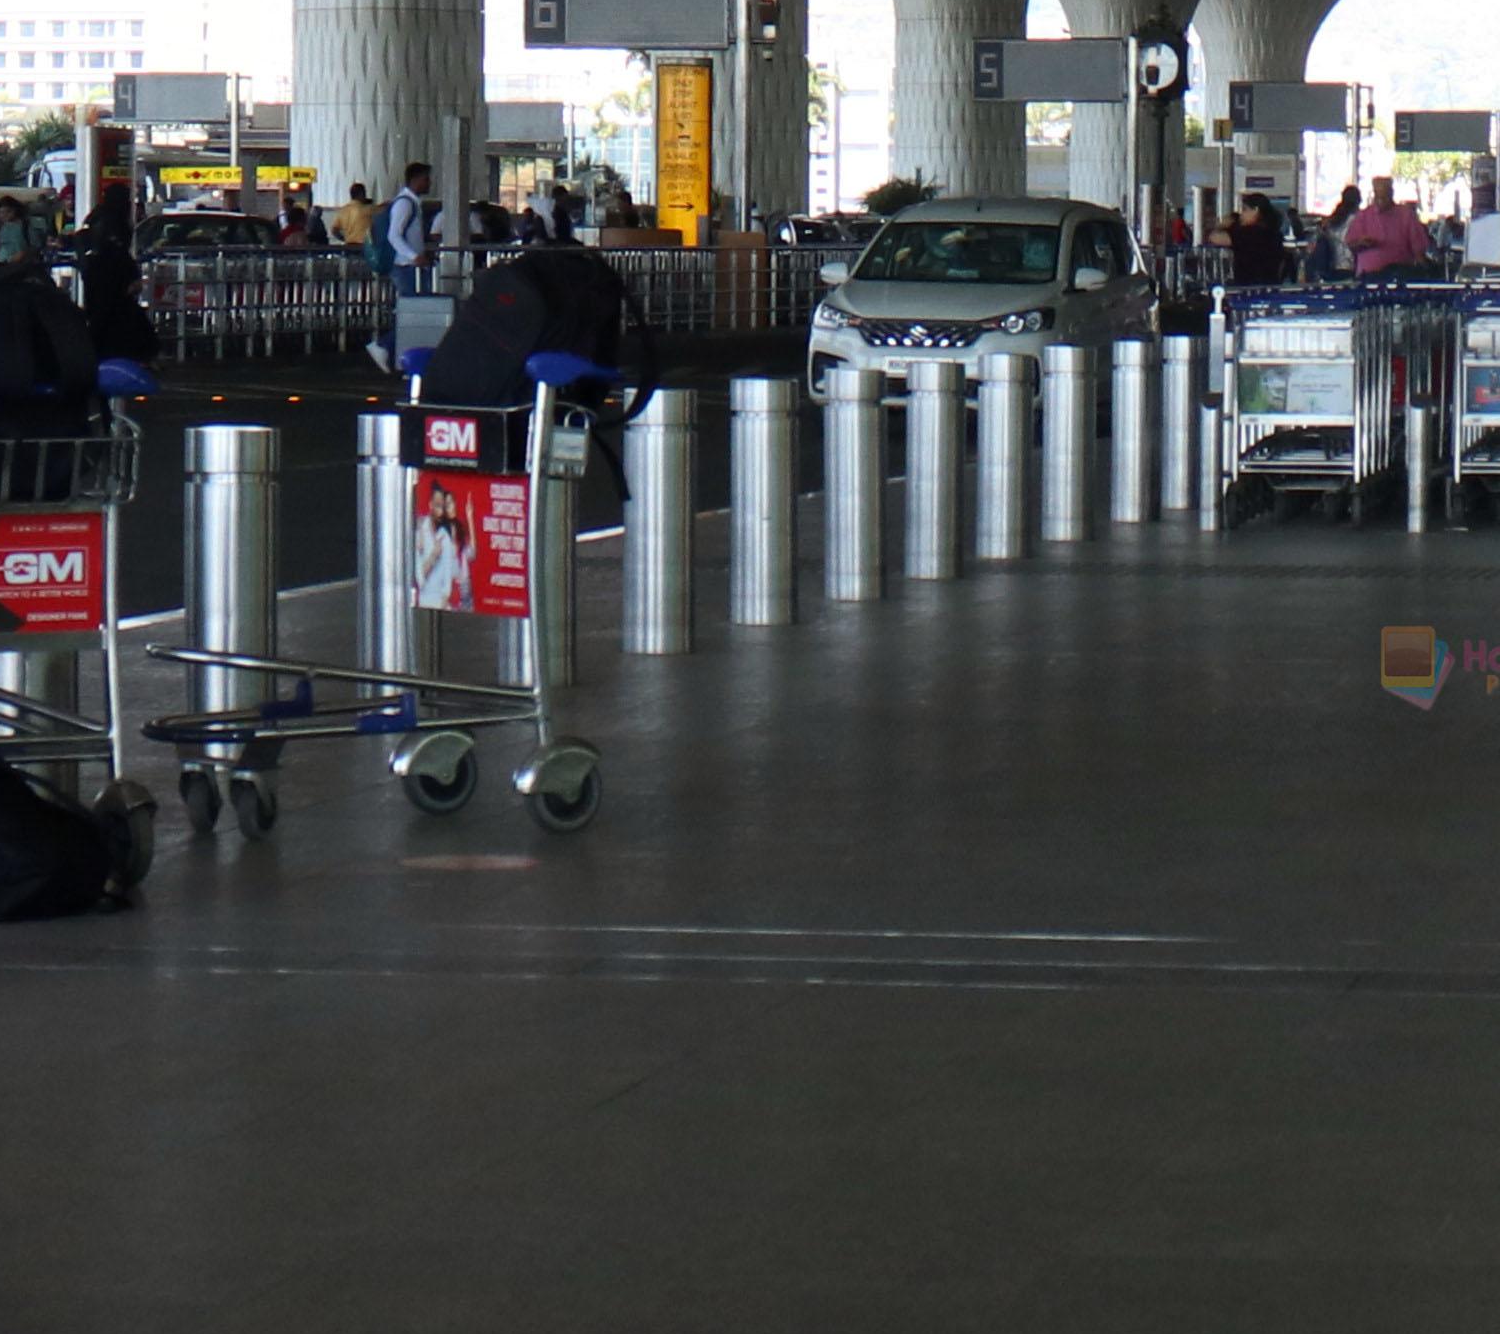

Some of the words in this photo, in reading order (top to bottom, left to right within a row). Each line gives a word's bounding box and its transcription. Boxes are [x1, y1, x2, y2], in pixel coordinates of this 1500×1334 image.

[980, 53, 998, 88] 5
[117, 82, 132, 110] 4
[1233, 92, 1250, 121] 4
[429, 420, 477, 453] GM
[0, 552, 84, 585] GM
